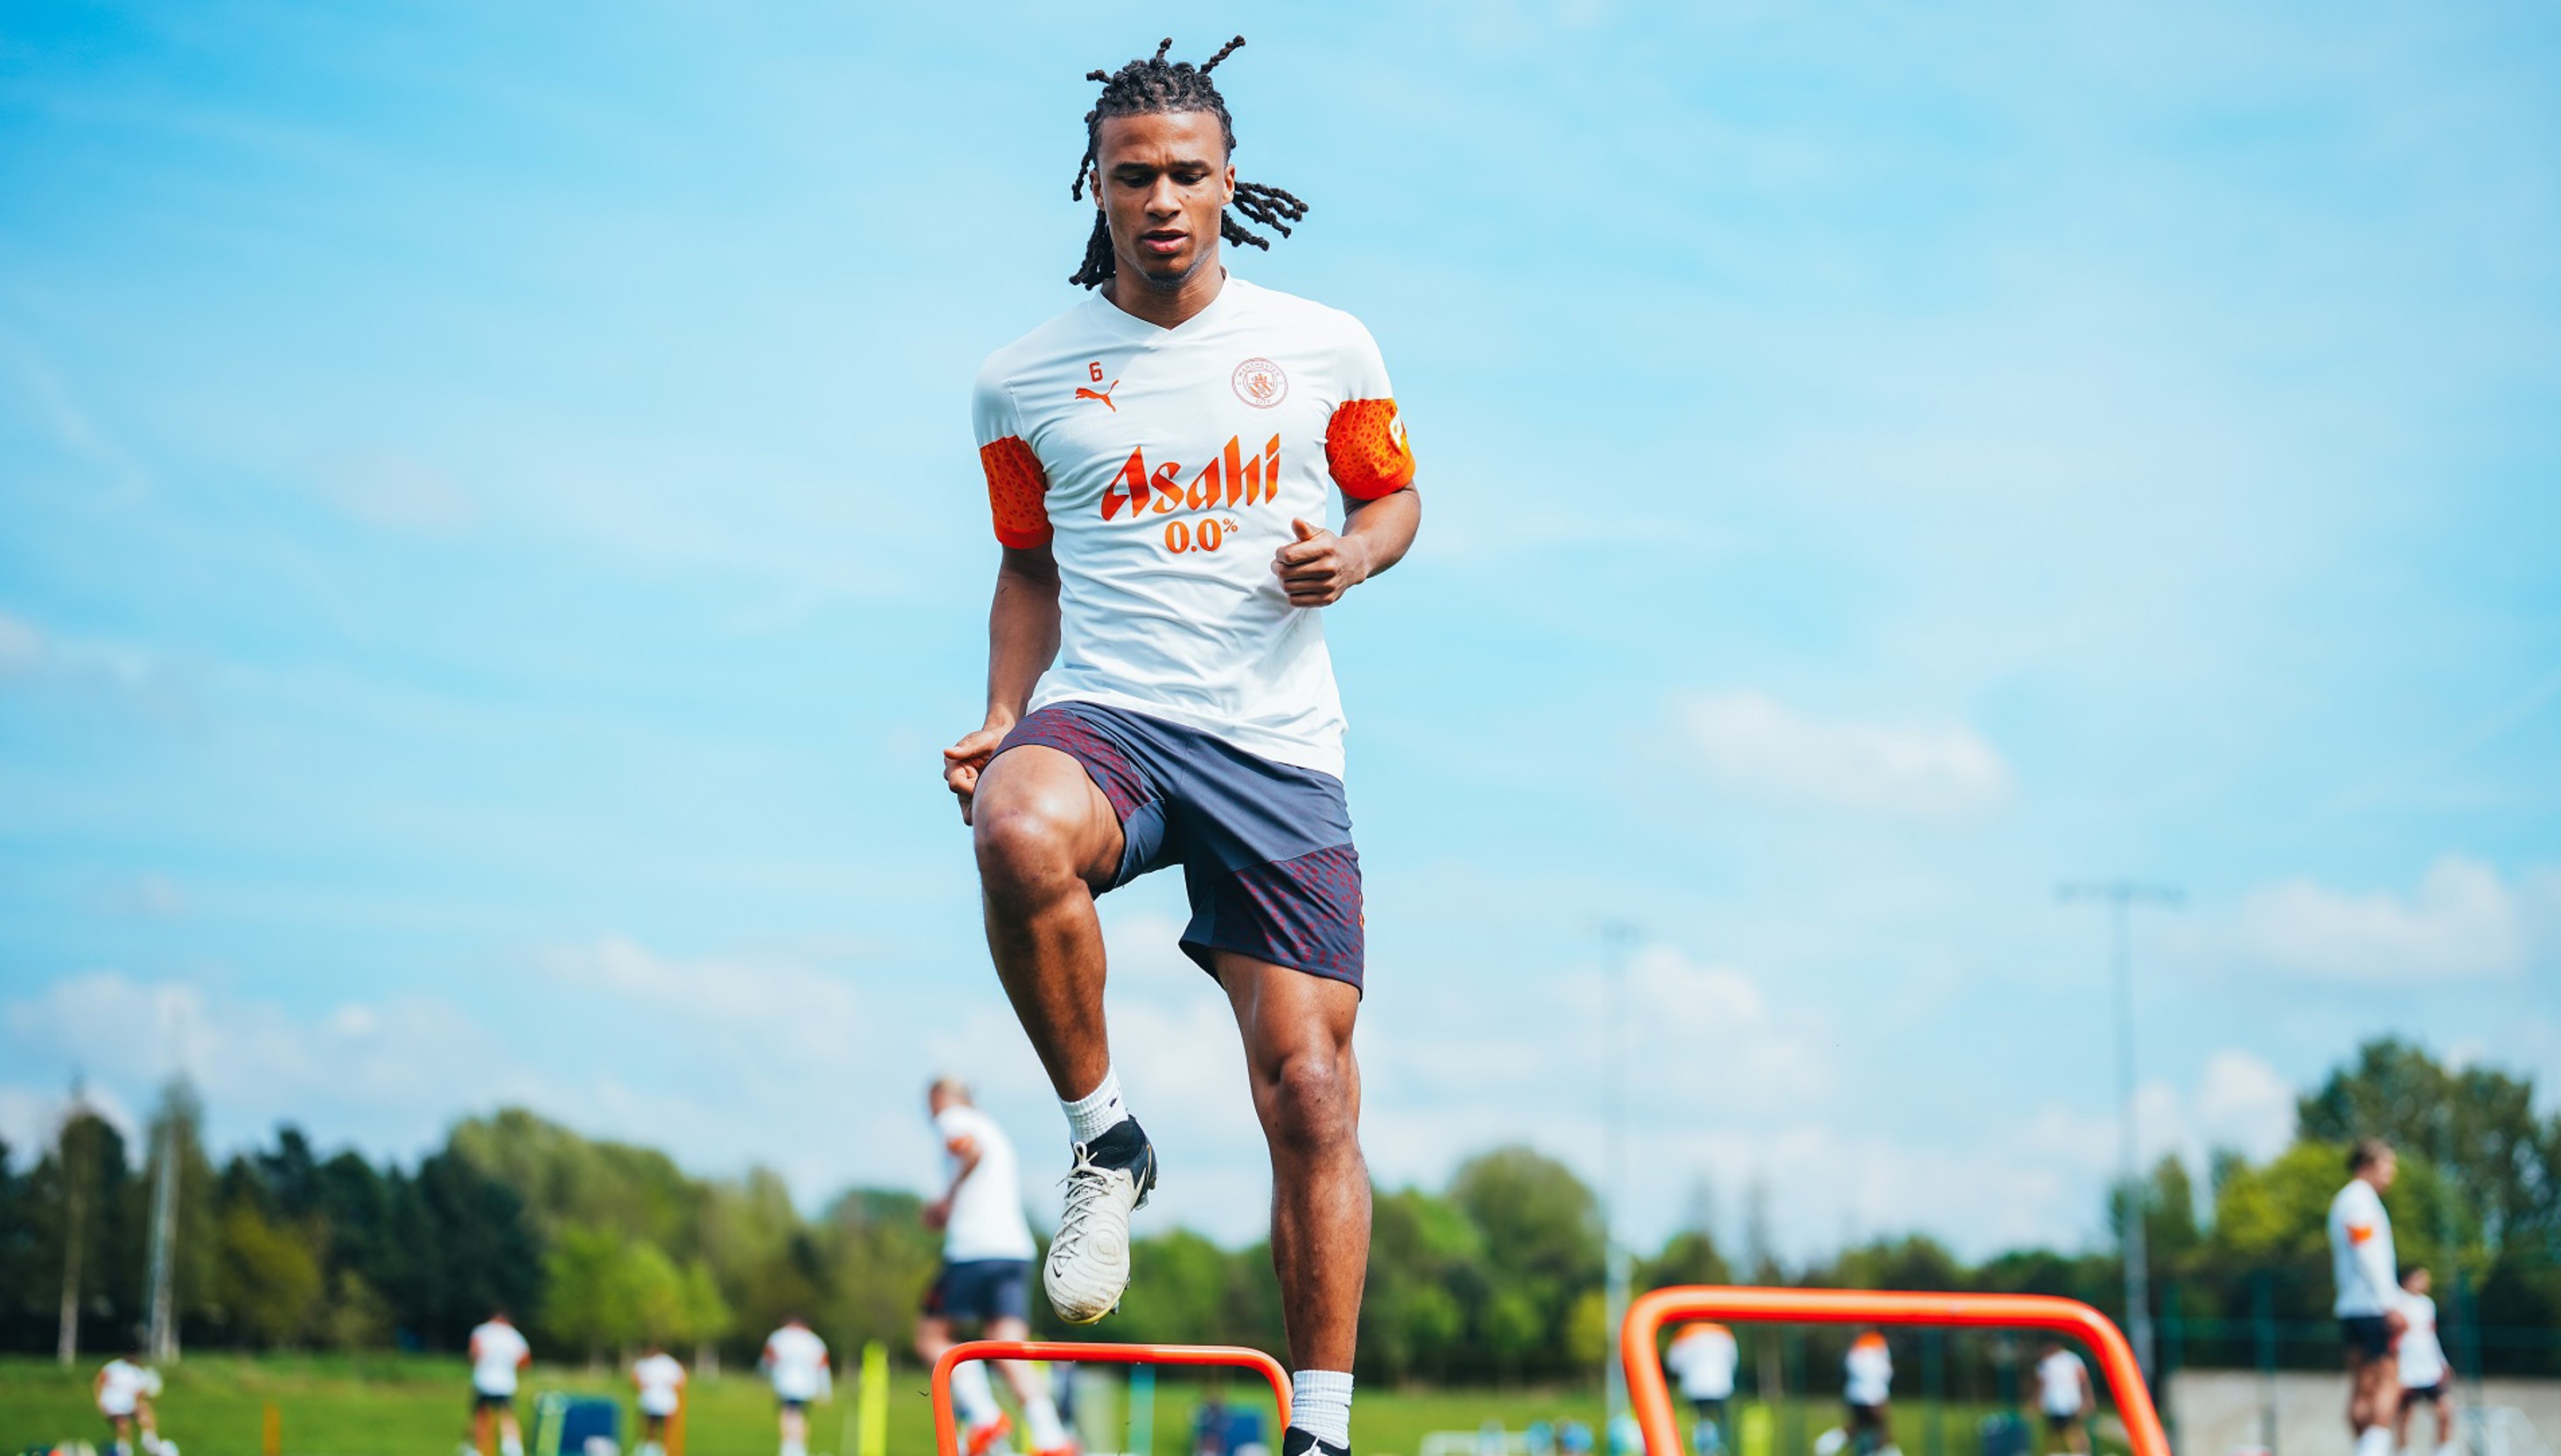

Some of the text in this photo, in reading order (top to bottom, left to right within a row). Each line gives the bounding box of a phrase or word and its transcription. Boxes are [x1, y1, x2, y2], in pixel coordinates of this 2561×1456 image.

[1089, 361, 1103, 382] 6
[1100, 432, 1280, 521] Asahi
[1164, 518, 1239, 554] 0.0%
